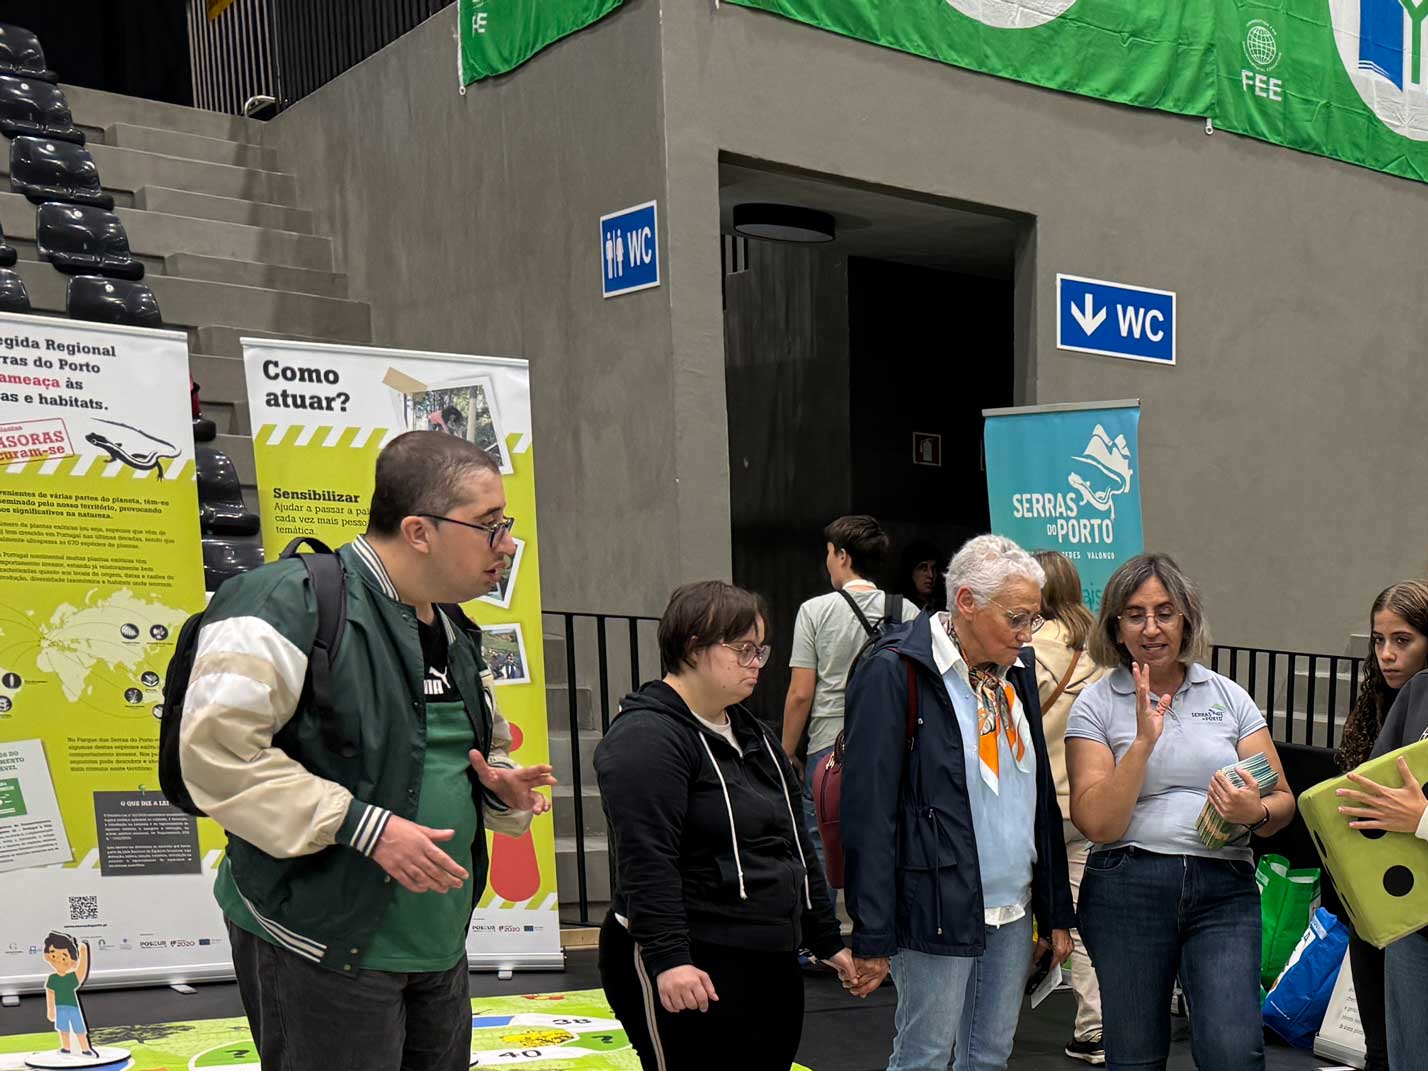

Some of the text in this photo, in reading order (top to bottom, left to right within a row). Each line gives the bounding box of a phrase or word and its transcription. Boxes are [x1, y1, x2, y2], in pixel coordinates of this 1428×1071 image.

[1241, 69, 1282, 102] FEE
[628, 227, 651, 267] WC
[1117, 304, 1164, 342] WC
[44, 339, 117, 357] Regional
[0, 354, 101, 374] ras do Porto
[262, 359, 340, 385] Como
[0, 374, 84, 390] ameaça às
[24, 393, 34, 404] e
[38, 393, 109, 410] habitats.
[265, 389, 351, 412] atuar?
[273, 487, 360, 503] Sensibilizar
[274, 502, 304, 513] Ajudar
[315, 505, 345, 516] passar
[1012, 492, 1078, 519] SERRAS
[275, 514, 368, 528] cada vez mais pesso
[1057, 519, 1114, 544] PORTO
[1087, 551, 1115, 560] VALONGO
[498, 1049, 542, 1059] 40
